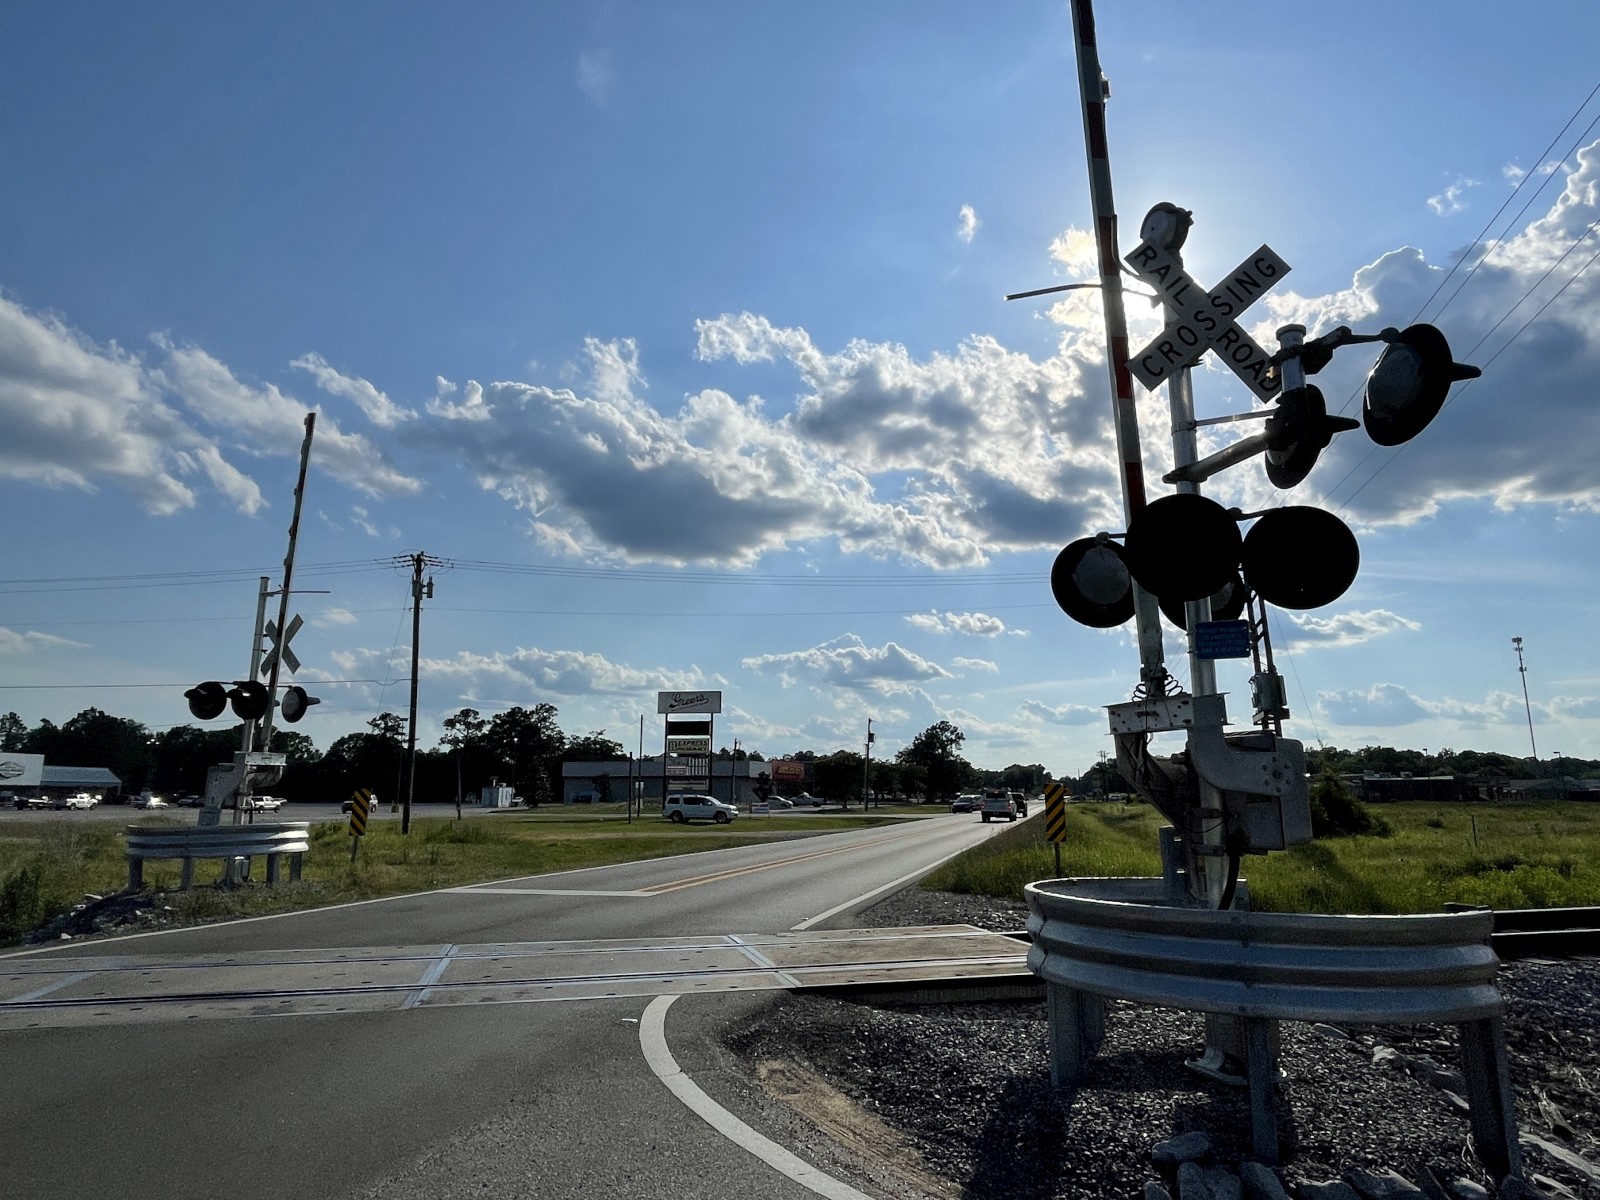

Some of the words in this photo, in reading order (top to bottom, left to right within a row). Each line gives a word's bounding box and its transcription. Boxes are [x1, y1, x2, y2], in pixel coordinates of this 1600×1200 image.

[1134, 245, 1190, 307] RAIL
[1216, 327, 1281, 392] ROAD
[1142, 257, 1277, 378] CROSSING
